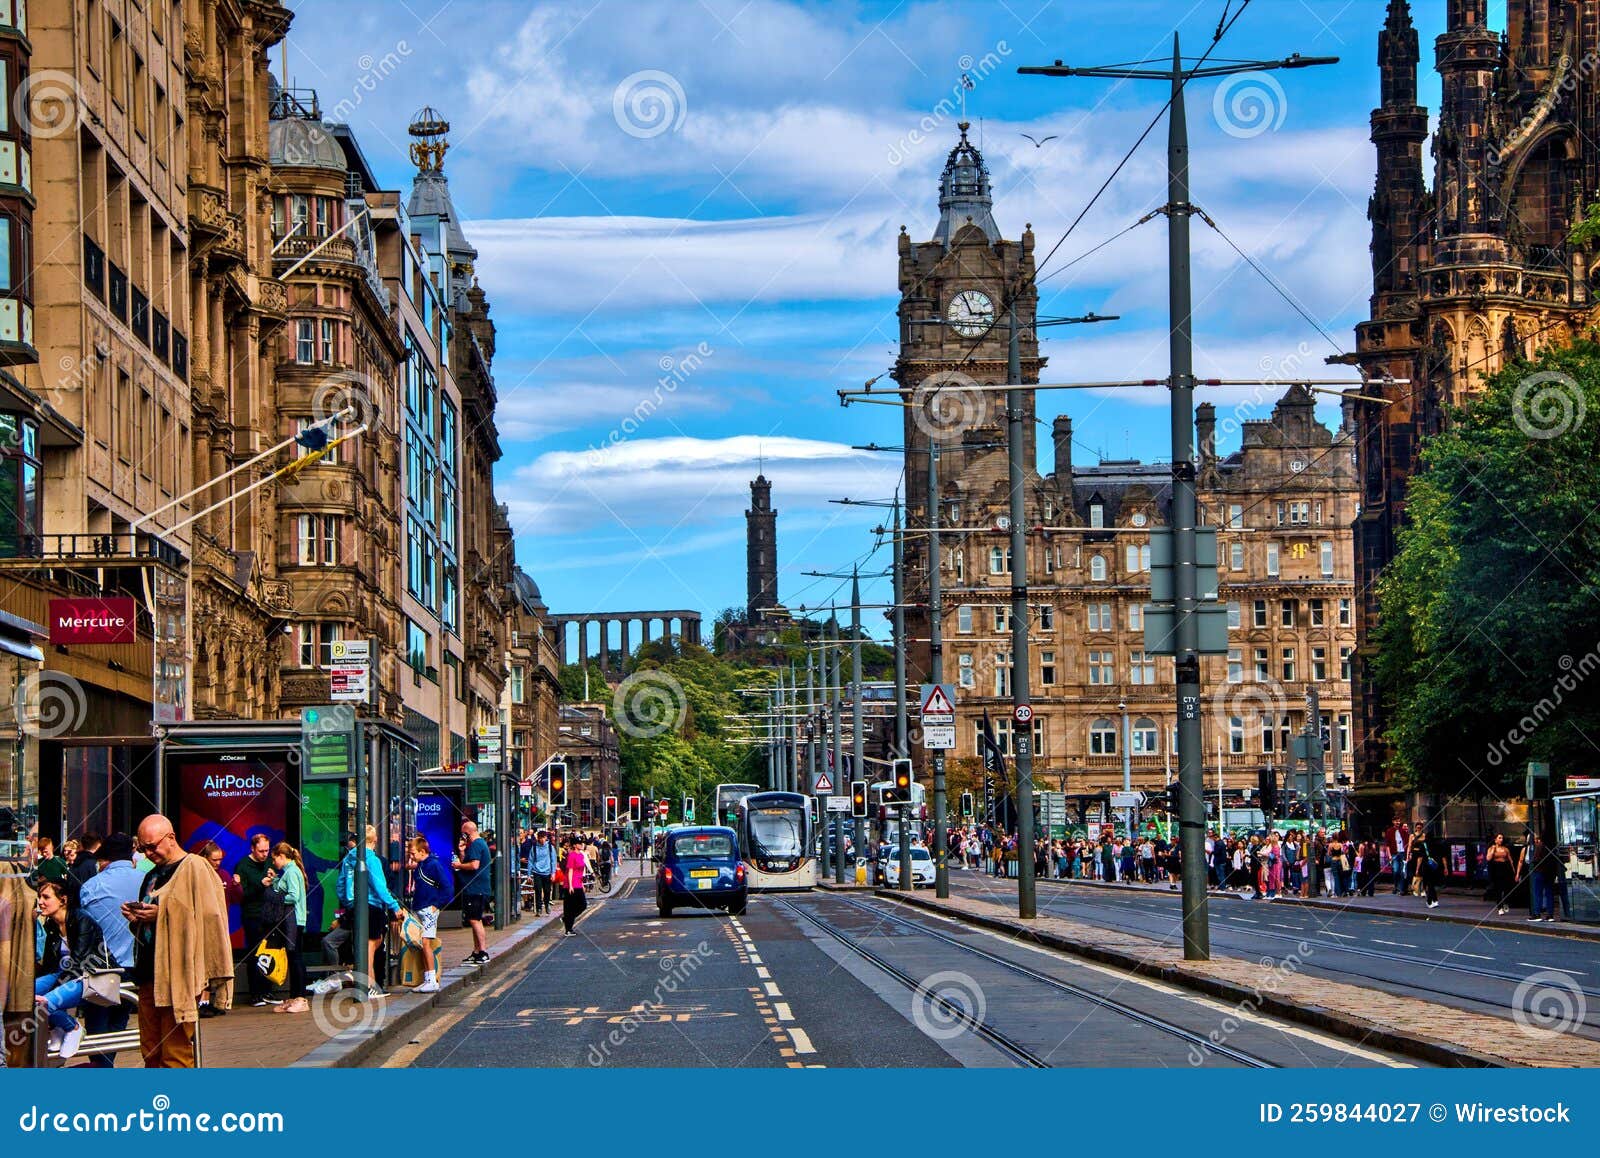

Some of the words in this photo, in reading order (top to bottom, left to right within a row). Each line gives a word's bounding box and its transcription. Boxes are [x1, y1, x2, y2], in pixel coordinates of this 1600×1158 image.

[59, 616, 125, 628] Mercure
[1017, 709, 1030, 718] 20
[203, 774, 264, 789] AirPods
